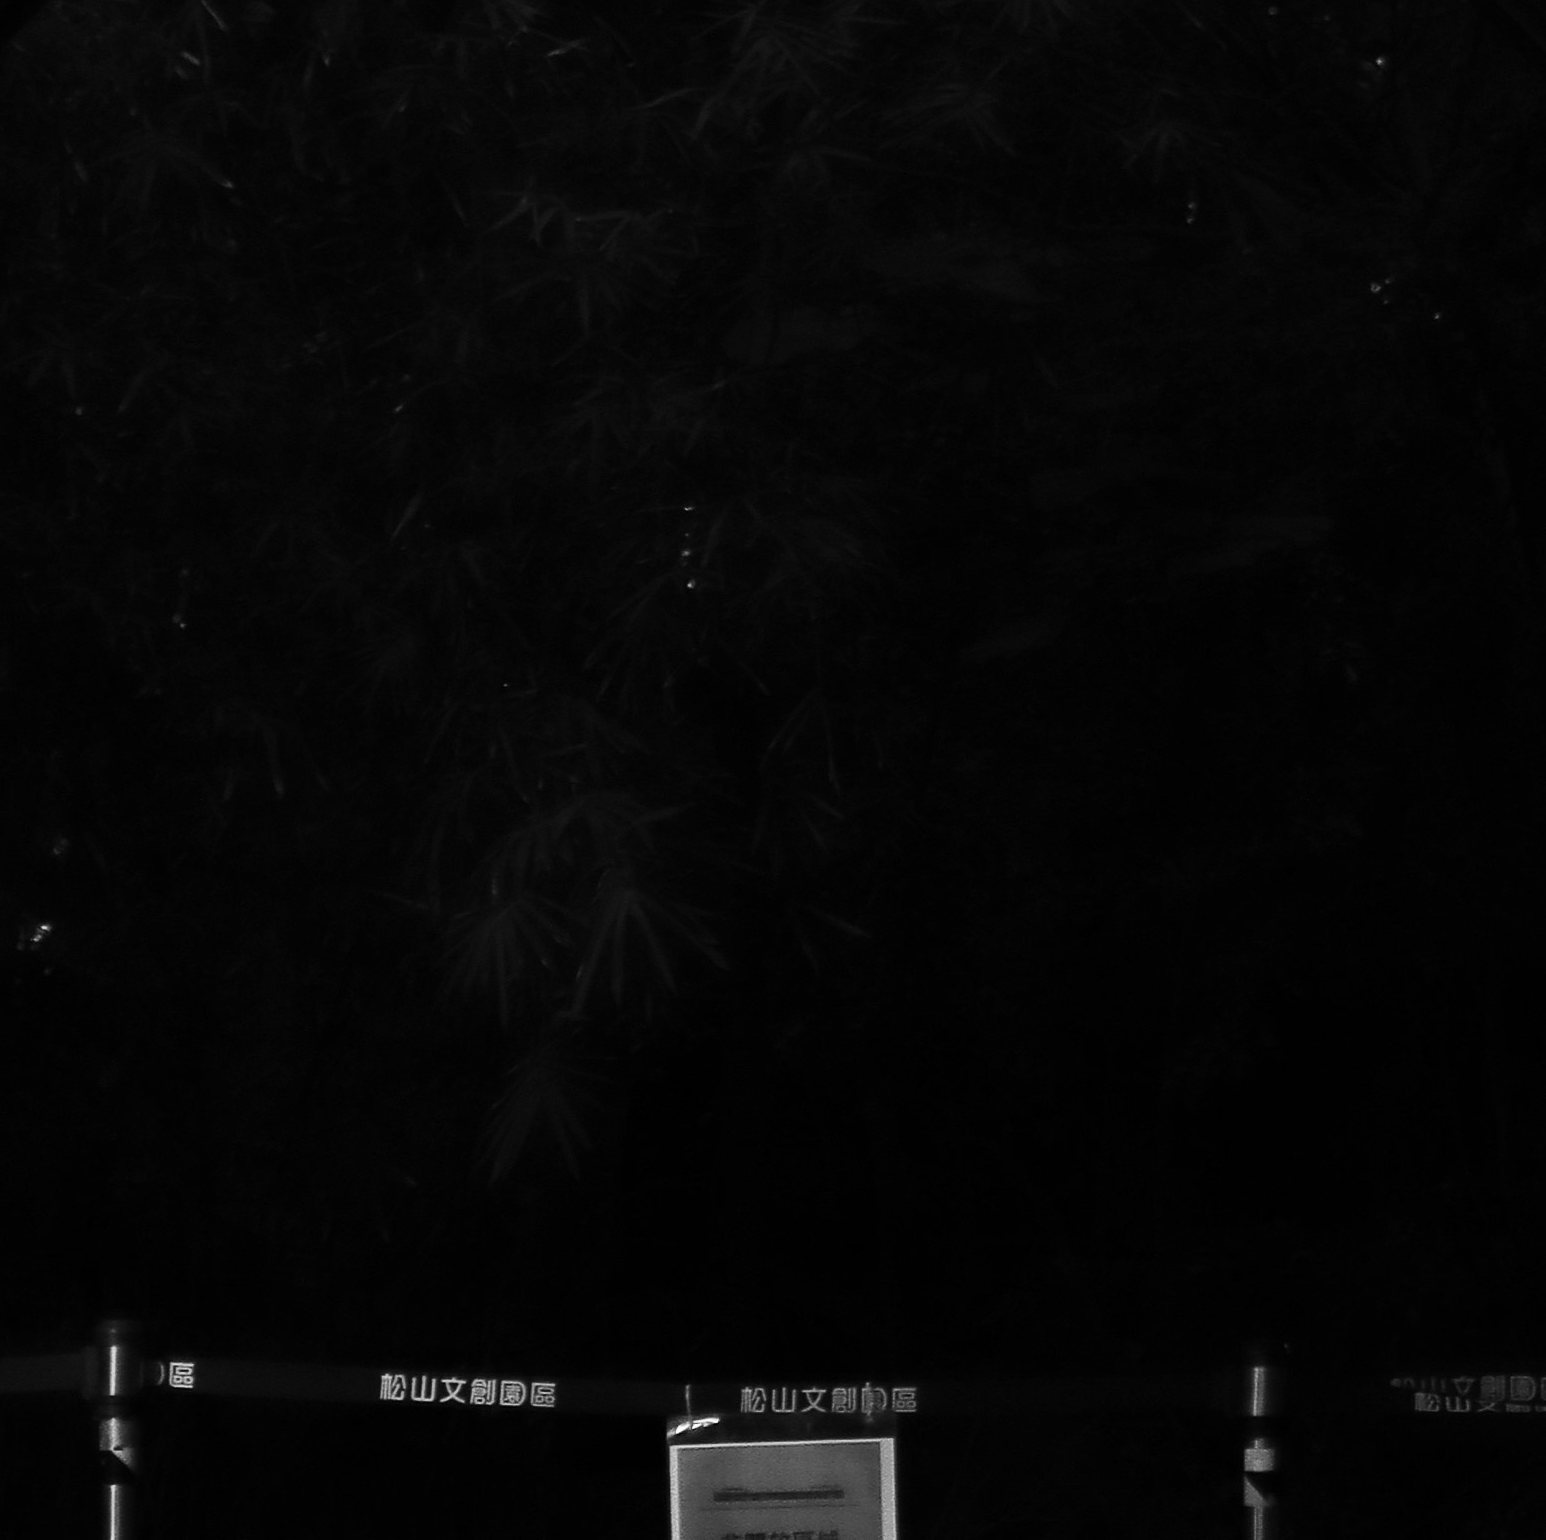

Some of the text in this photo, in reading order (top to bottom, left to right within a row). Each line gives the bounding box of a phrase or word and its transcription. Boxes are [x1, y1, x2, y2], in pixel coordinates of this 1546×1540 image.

[380, 1373, 556, 1408] 松山文創園區
[740, 1382, 918, 1414] 松山文創園區
